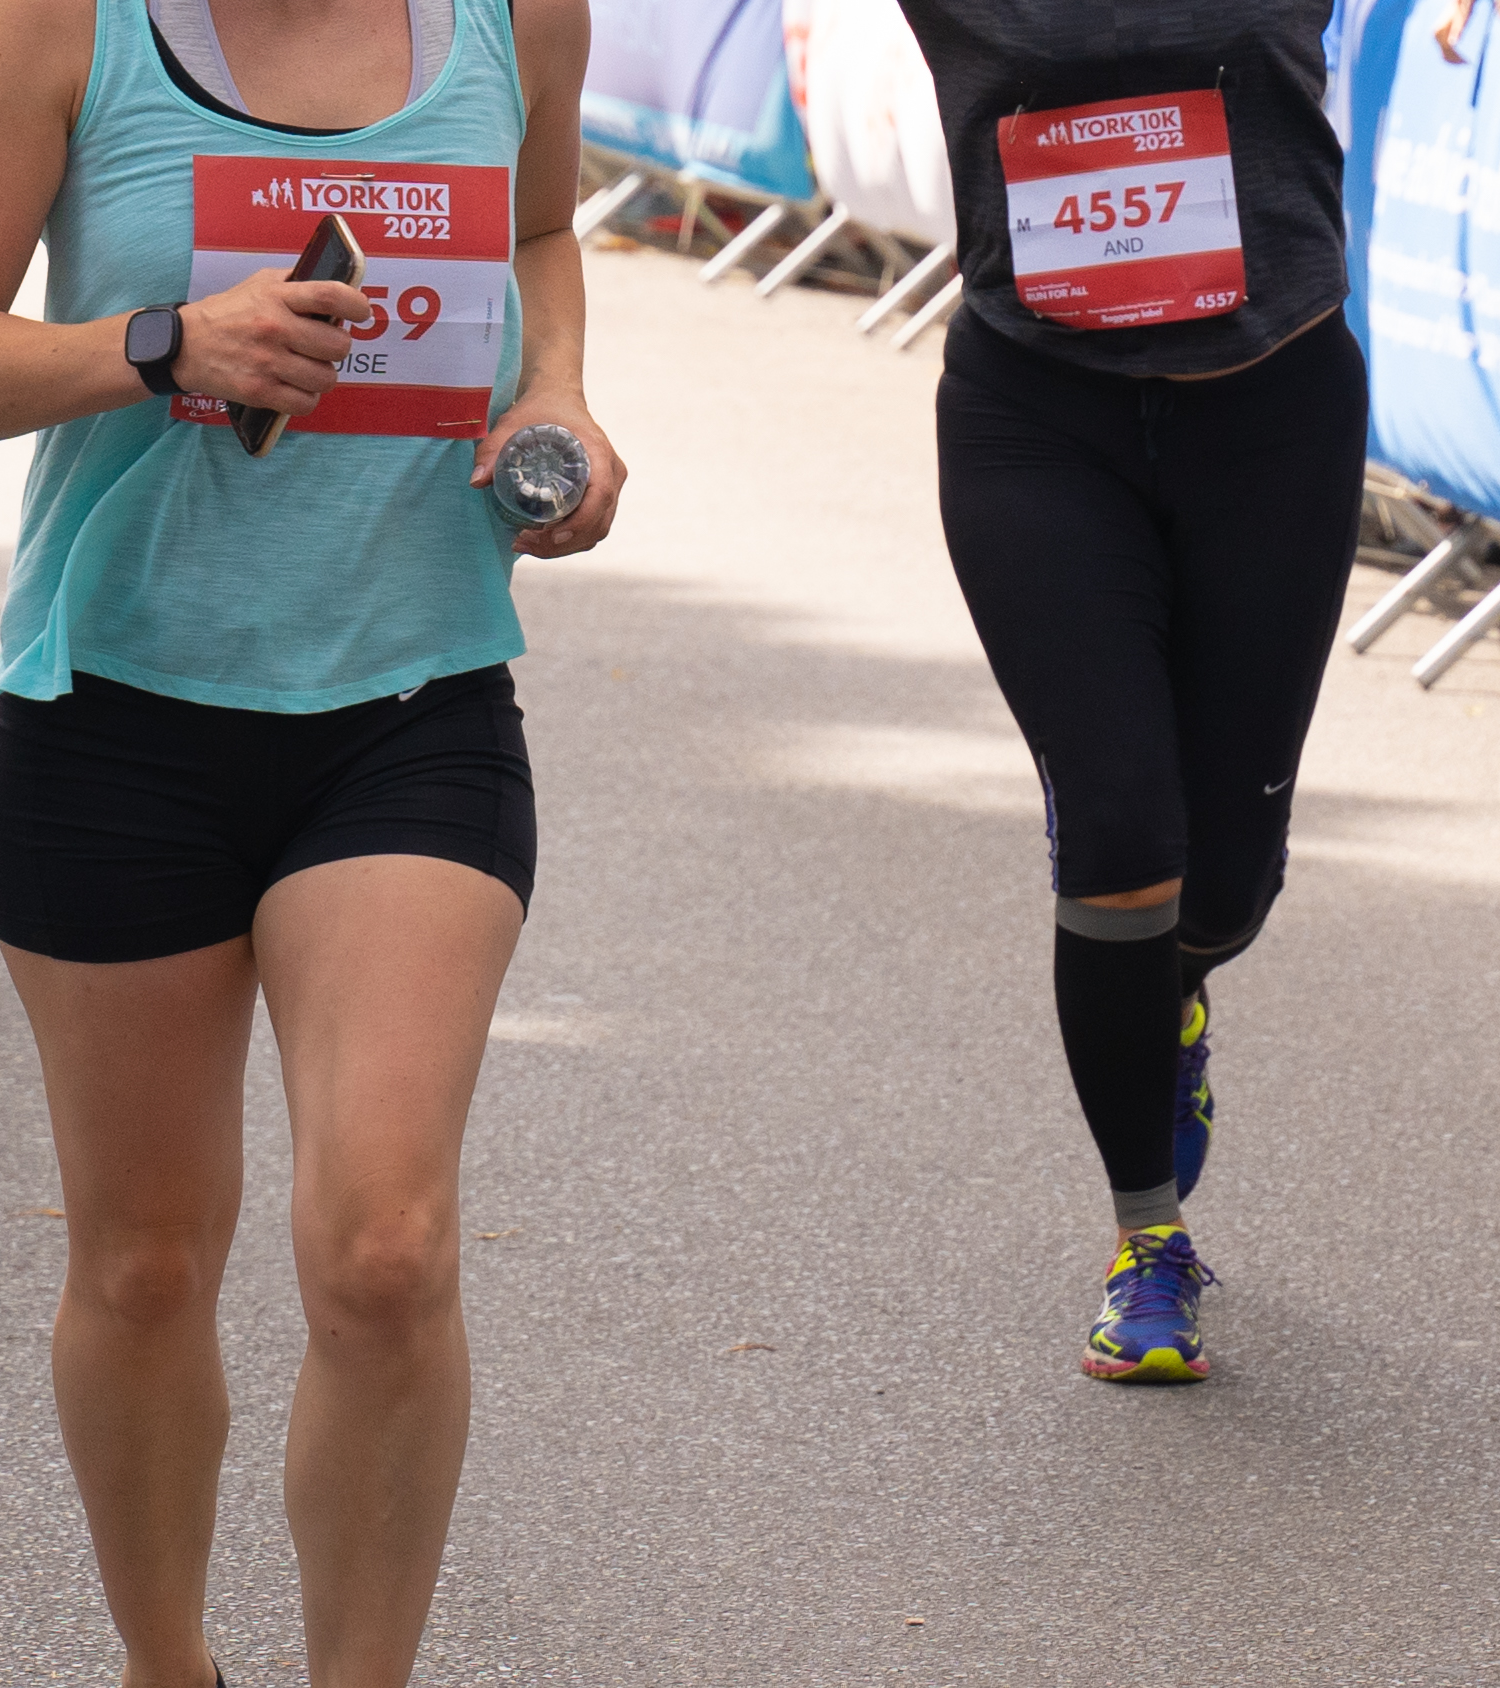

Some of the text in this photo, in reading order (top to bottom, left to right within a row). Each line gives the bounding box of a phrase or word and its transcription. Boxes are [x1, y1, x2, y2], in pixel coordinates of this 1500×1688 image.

[1075, 110, 1177, 139] YORK 10K
[1134, 132, 1184, 152] 2022
[304, 183, 445, 212] YORK 10K
[1017, 218, 1031, 233] M
[1053, 181, 1187, 235] 4557
[384, 216, 450, 239] 2022
[1103, 237, 1144, 257] AND
[1194, 291, 1237, 310] 4557
[181, 396, 212, 411] RUN
